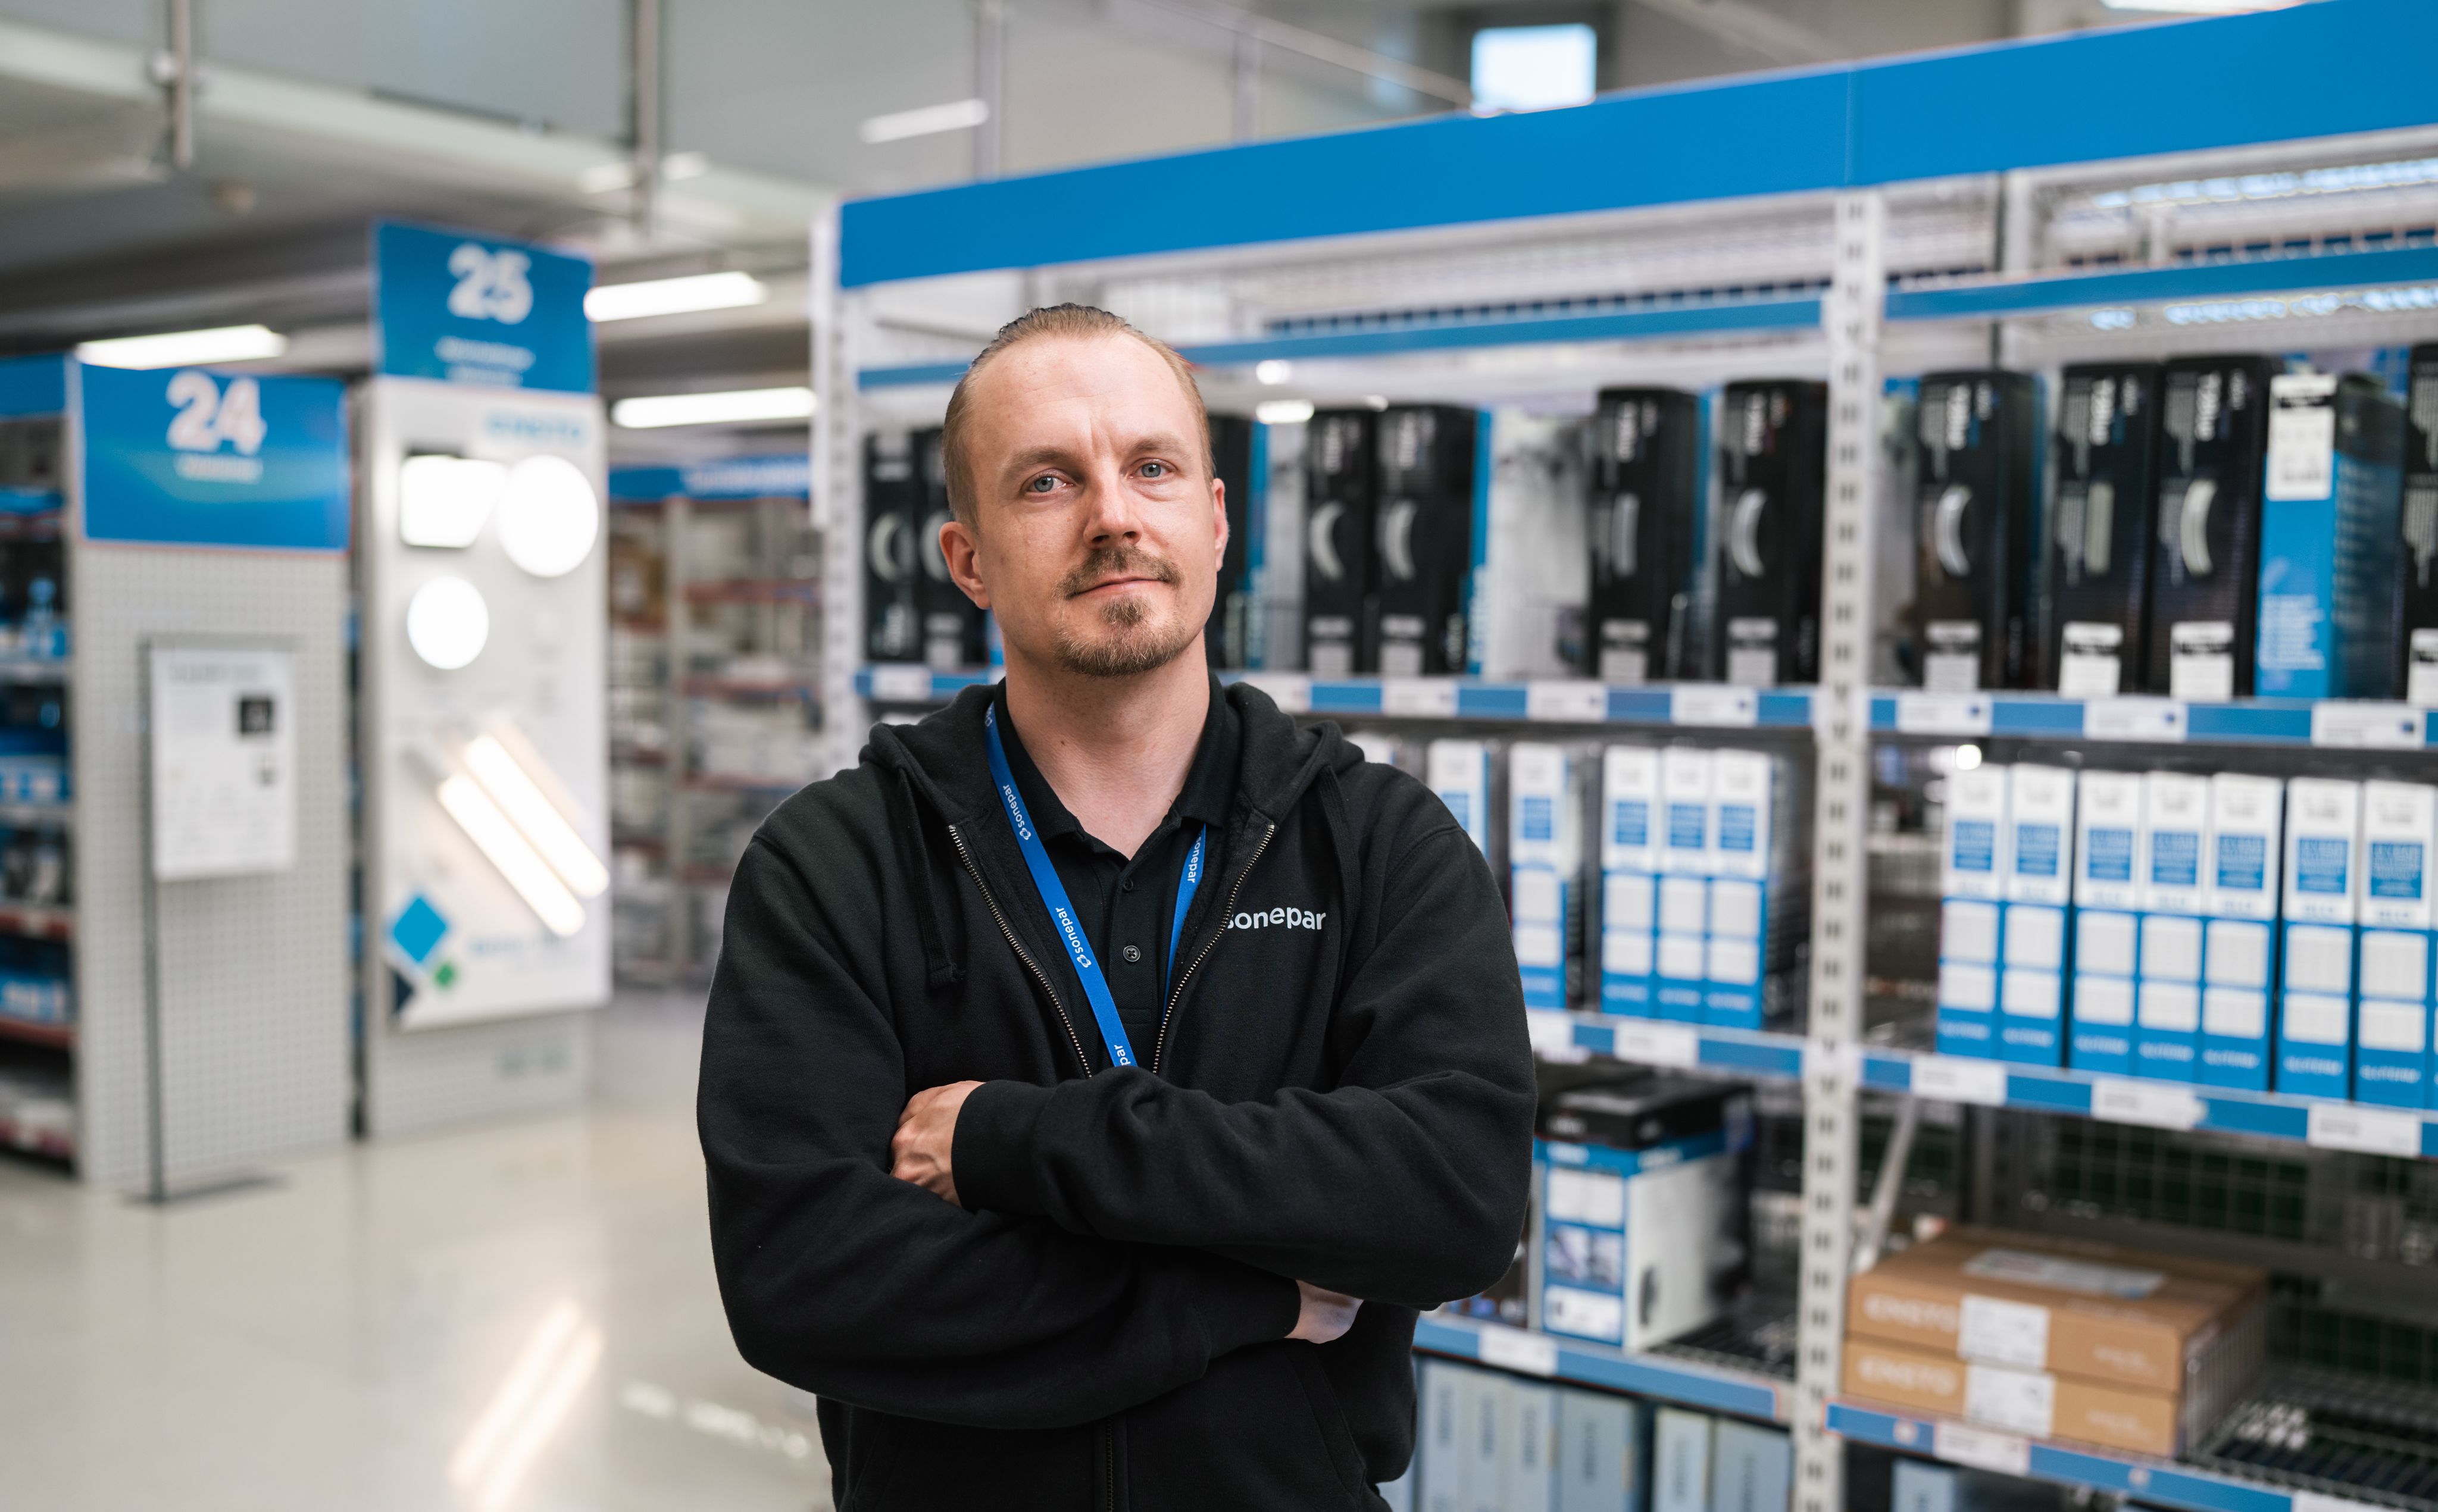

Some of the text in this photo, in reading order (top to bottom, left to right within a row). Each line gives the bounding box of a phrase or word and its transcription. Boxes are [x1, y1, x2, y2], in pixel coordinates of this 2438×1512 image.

[446, 242, 534, 325] 25
[166, 371, 267, 456] 24
[1003, 784, 1025, 828] sonepar
[1187, 837, 1201, 883] sonepar
[1055, 907, 1083, 953] sonepar
